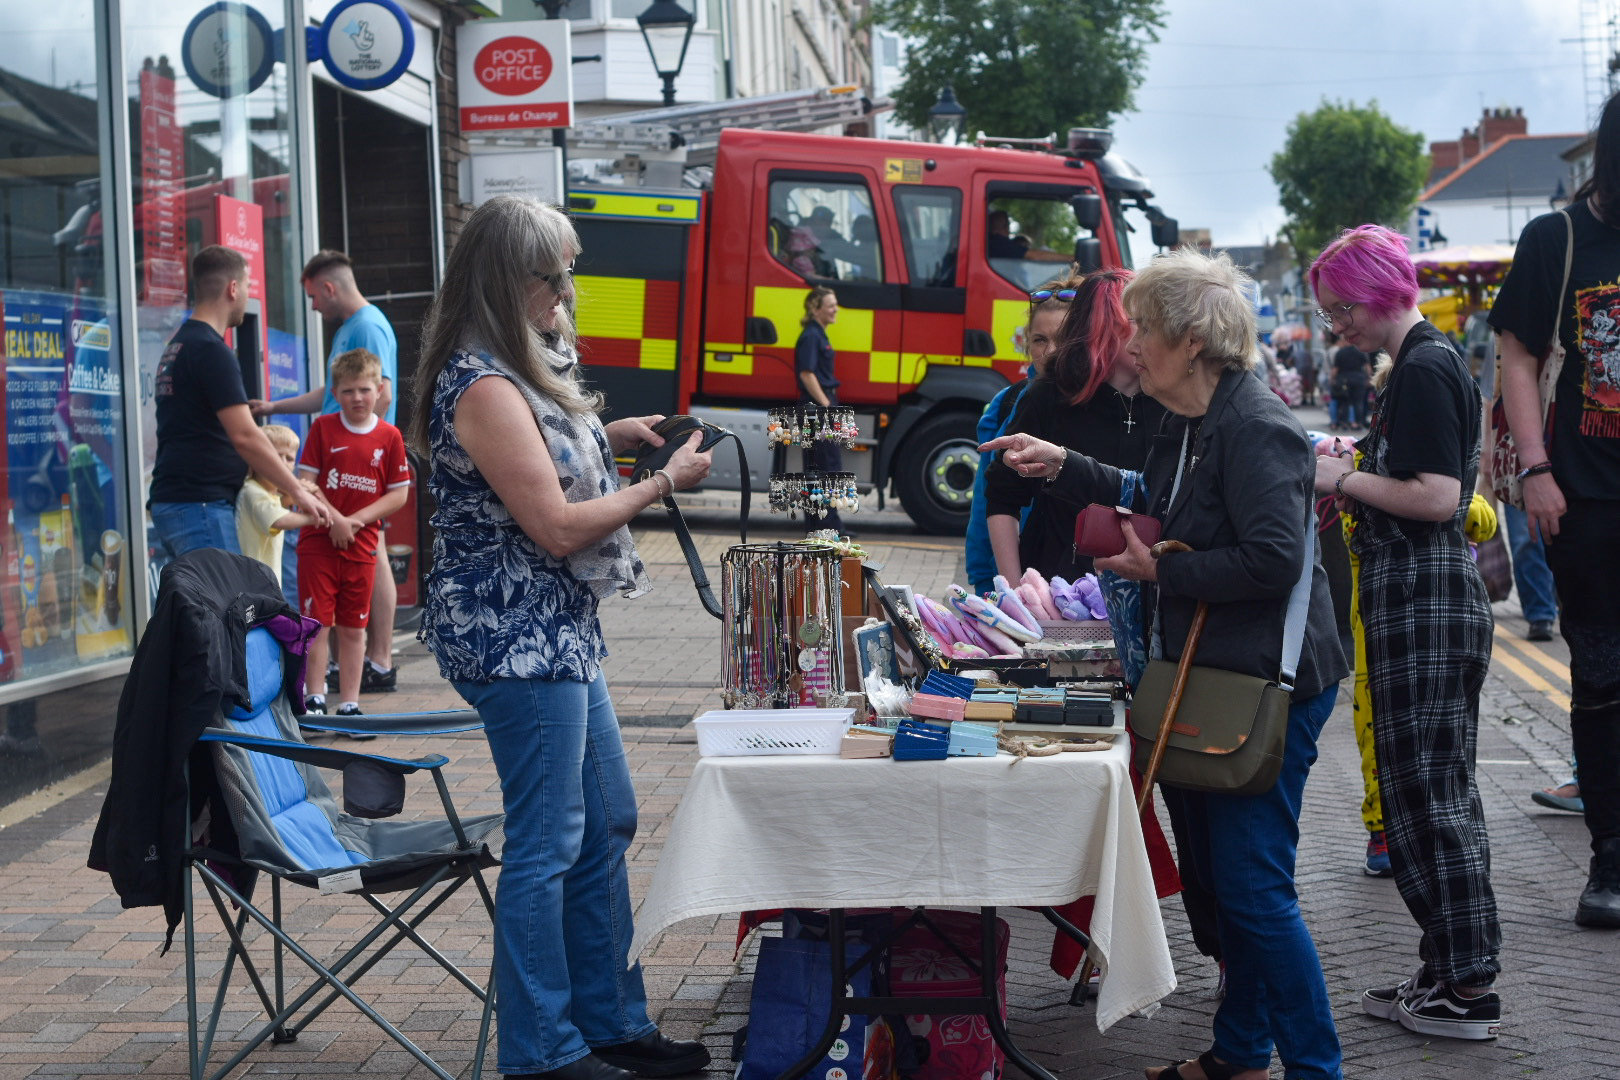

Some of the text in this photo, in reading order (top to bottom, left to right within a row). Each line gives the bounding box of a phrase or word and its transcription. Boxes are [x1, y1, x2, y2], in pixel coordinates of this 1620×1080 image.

[492, 48, 536, 65] POST
[482, 65, 544, 82] OFFICE
[470, 110, 559, 124] Bureau de Change
[34, 331, 64, 359] DEAL
[68, 363, 120, 391] Coffee & Cake
[340, 480, 377, 494] chartered
[341, 473, 376, 486] standard
